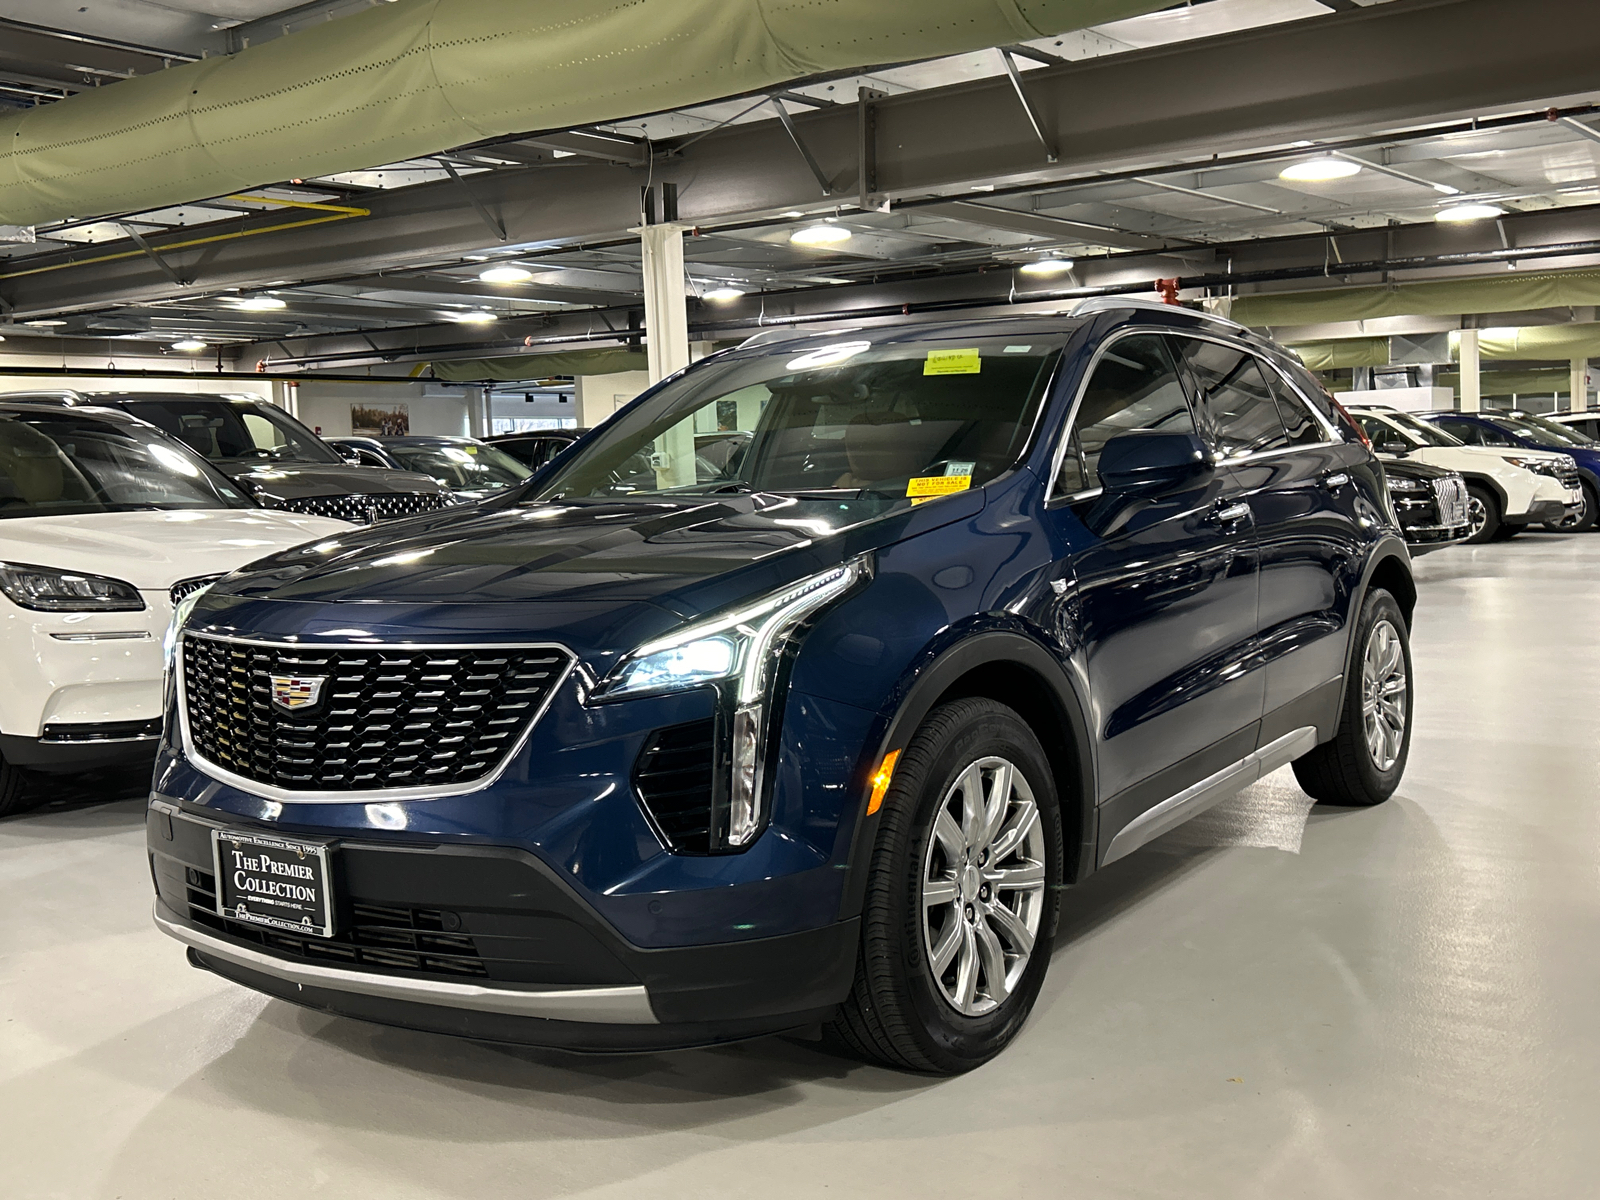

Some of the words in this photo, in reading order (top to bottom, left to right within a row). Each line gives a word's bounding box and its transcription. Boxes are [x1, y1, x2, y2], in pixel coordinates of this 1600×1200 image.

[253, 837, 284, 848] EXCELLENCE
[302, 845, 318, 854] 1995
[231, 850, 260, 871] THE
[259, 854, 314, 880] PREMIER
[233, 870, 316, 902] COLLECTION
[247, 895, 275, 905] EVERYTHING
[274, 899, 291, 908] STARTS
